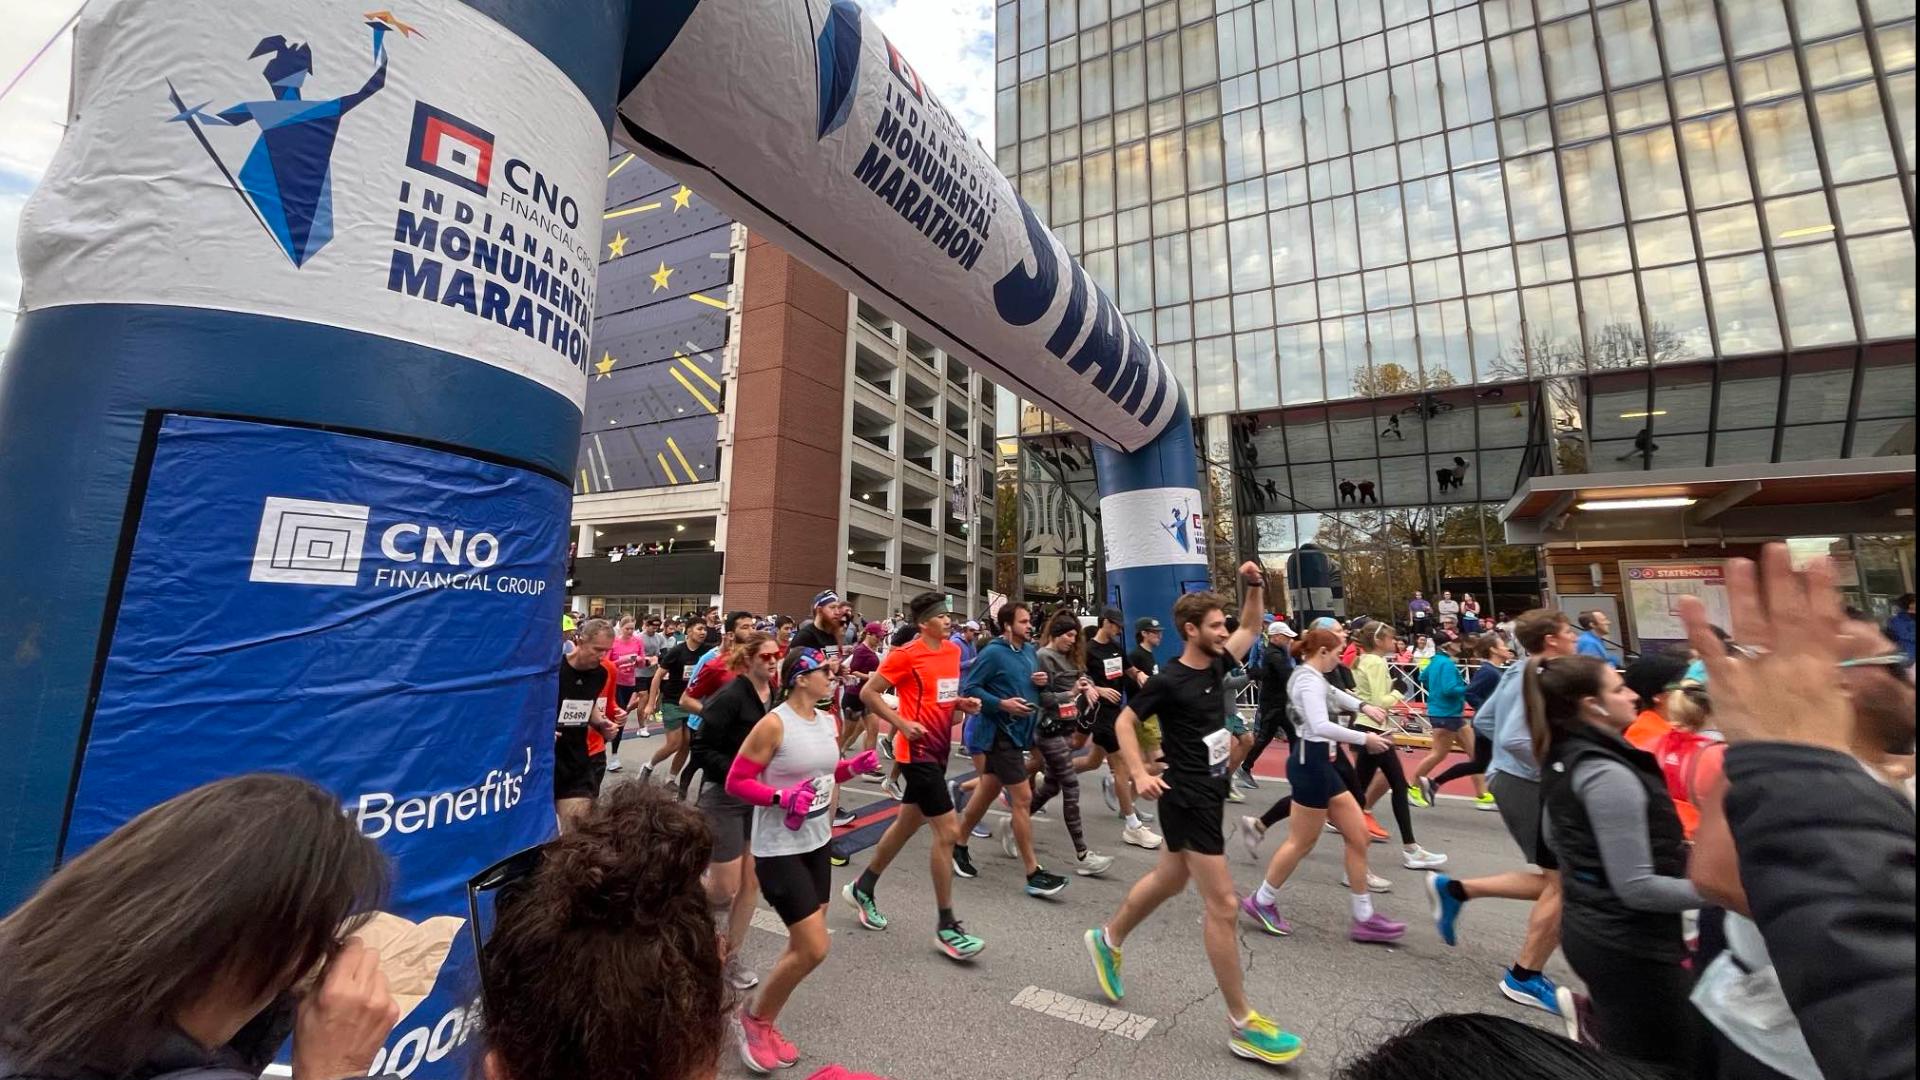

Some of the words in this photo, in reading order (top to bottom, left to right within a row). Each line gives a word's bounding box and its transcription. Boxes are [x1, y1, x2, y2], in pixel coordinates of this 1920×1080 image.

[504, 158, 580, 230] CNO
[874, 106, 992, 241] MONUMENTAL
[886, 82, 998, 215] INDIANAPOLIS
[500, 191, 575, 254] FINANCIAL
[853, 142, 985, 272] MARATHON
[387, 248, 589, 376] MARATHON
[394, 208, 591, 339] MONUMENTAL
[374, 568, 492, 592] FINANCIAL
[496, 576, 546, 596] GROUP
[380, 523, 499, 568] CNO
[1657, 568, 1720, 578] STATEHOUSE
